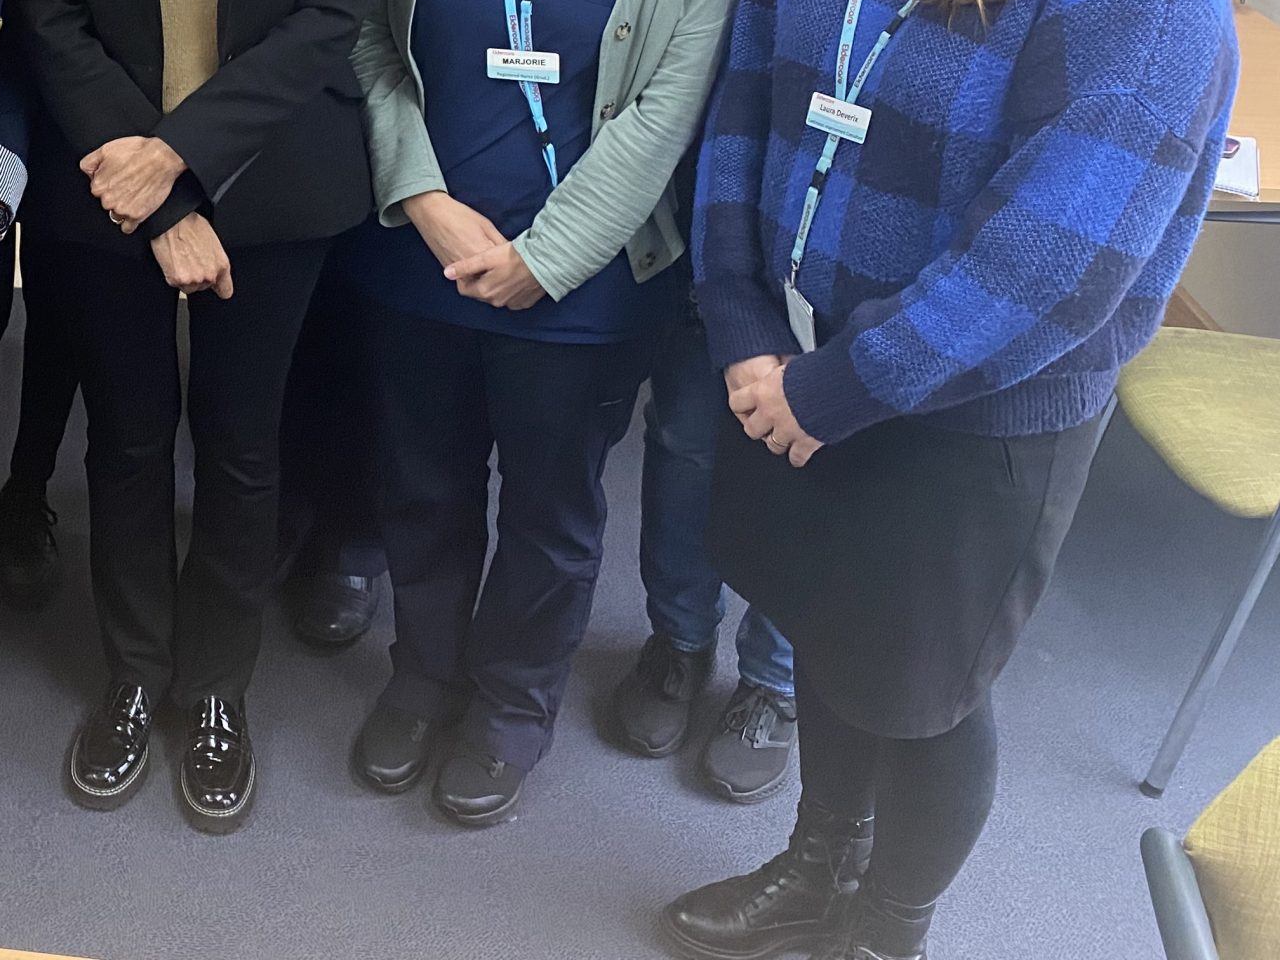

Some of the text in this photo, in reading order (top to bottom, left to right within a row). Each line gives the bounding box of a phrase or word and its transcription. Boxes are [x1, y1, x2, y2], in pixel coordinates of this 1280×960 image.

[502, 58, 546, 66] MARJORIE
[837, 44, 850, 84] Eldercare
[854, 52, 876, 88] Eldercare
[820, 104, 859, 123] Laura Deverix
